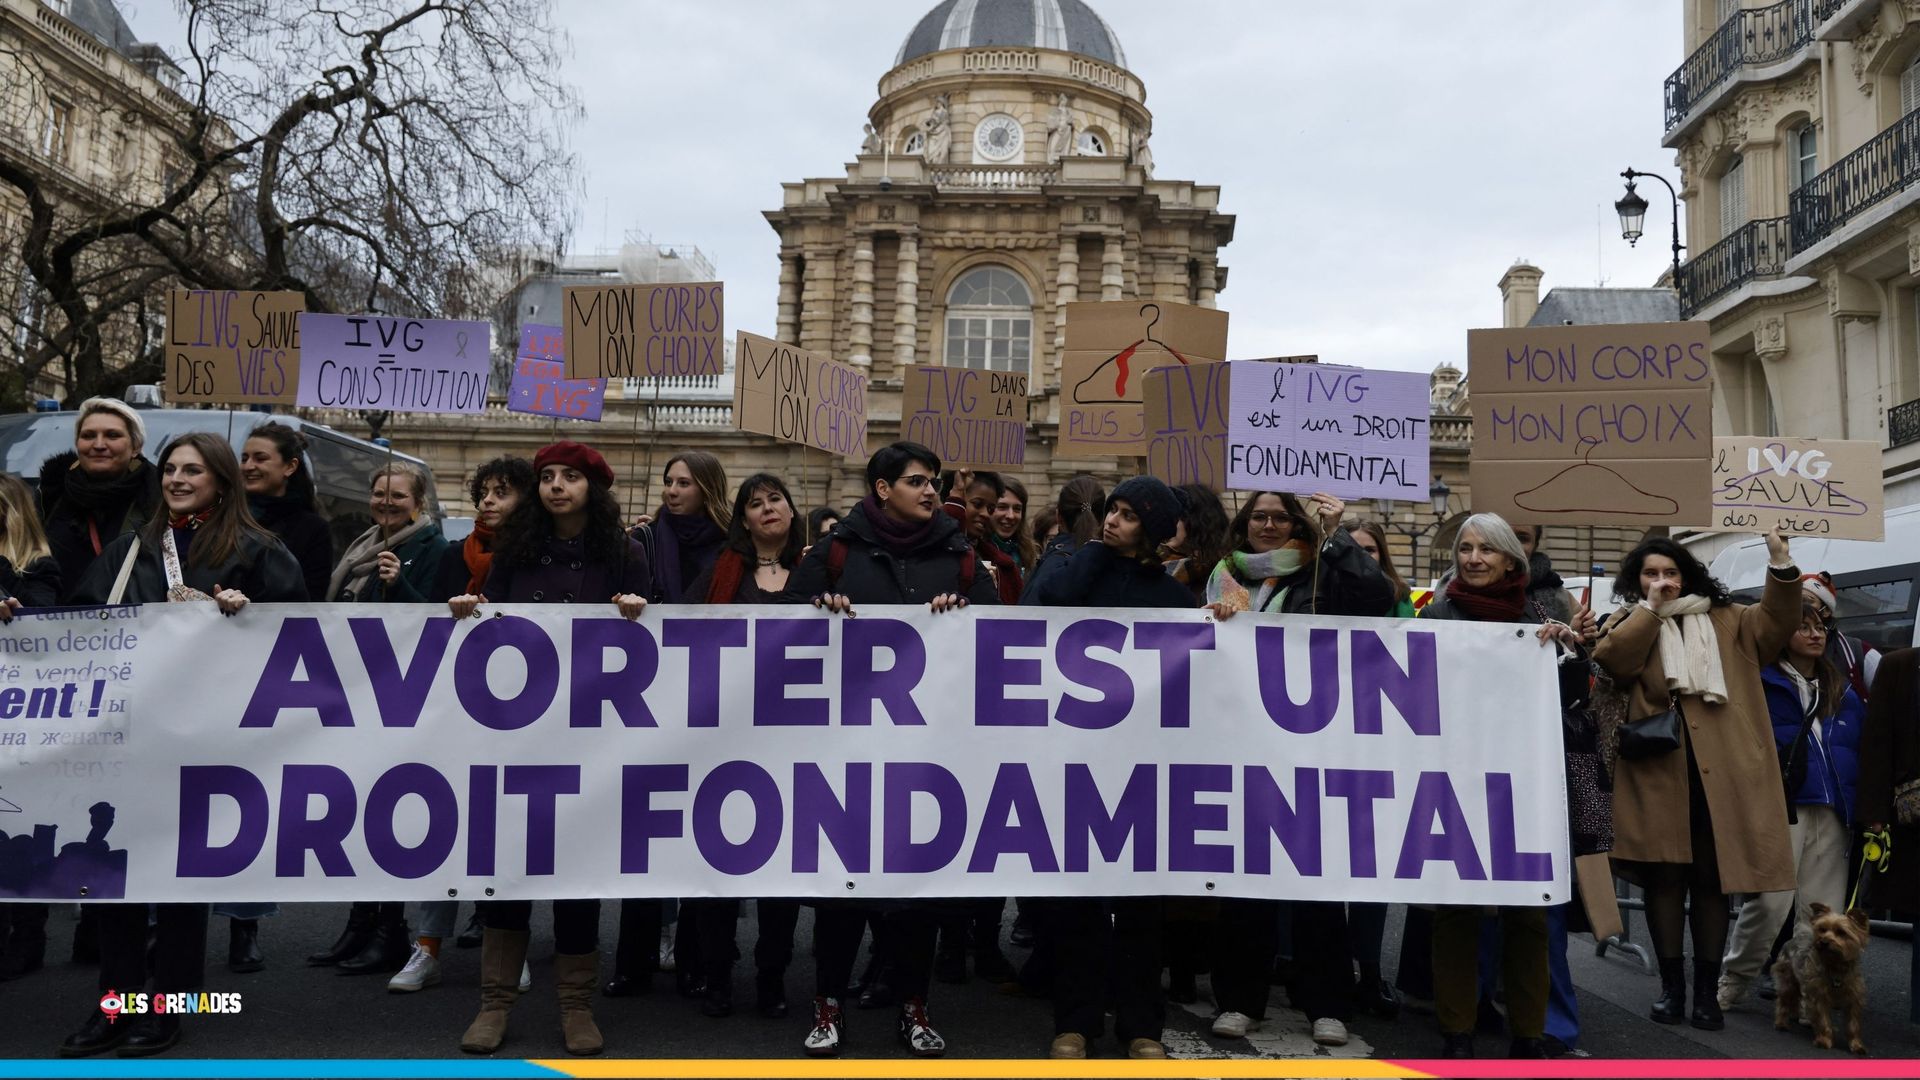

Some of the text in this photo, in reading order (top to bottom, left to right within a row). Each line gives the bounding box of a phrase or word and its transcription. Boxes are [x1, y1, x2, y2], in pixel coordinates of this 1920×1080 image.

[171, 290, 239, 349] L'IVG
[650, 286, 722, 333] CORPS
[345, 318, 425, 352] IVG
[646, 335, 717, 376] CHOIX
[237, 350, 286, 397] VIES
[1506, 343, 1709, 382] MON CORPS
[317, 360, 489, 410] CONSTITUTION
[527, 383, 593, 416] IVG
[818, 361, 865, 414] CORPS
[915, 368, 1026, 415] IVG DANS
[996, 398, 1012, 416] LA
[1069, 410, 1118, 437] PLUS
[1248, 409, 1425, 440] est un DROIT
[1492, 404, 1696, 444] MON CHOIX
[814, 404, 867, 459] CHOIX
[908, 416, 1026, 465] CONSTITUTION
[1149, 433, 1228, 488] CONST
[1230, 444, 1417, 487] FONDAMENTAL
[1723, 476, 1850, 507] SAUVE
[1723, 510, 1830, 533] des vies
[57, 628, 138, 652] decide
[238, 615, 1441, 736] AVORTER EST UN
[175, 762, 581, 880] DROIT
[620, 760, 1554, 881] FONDAMENTAL
